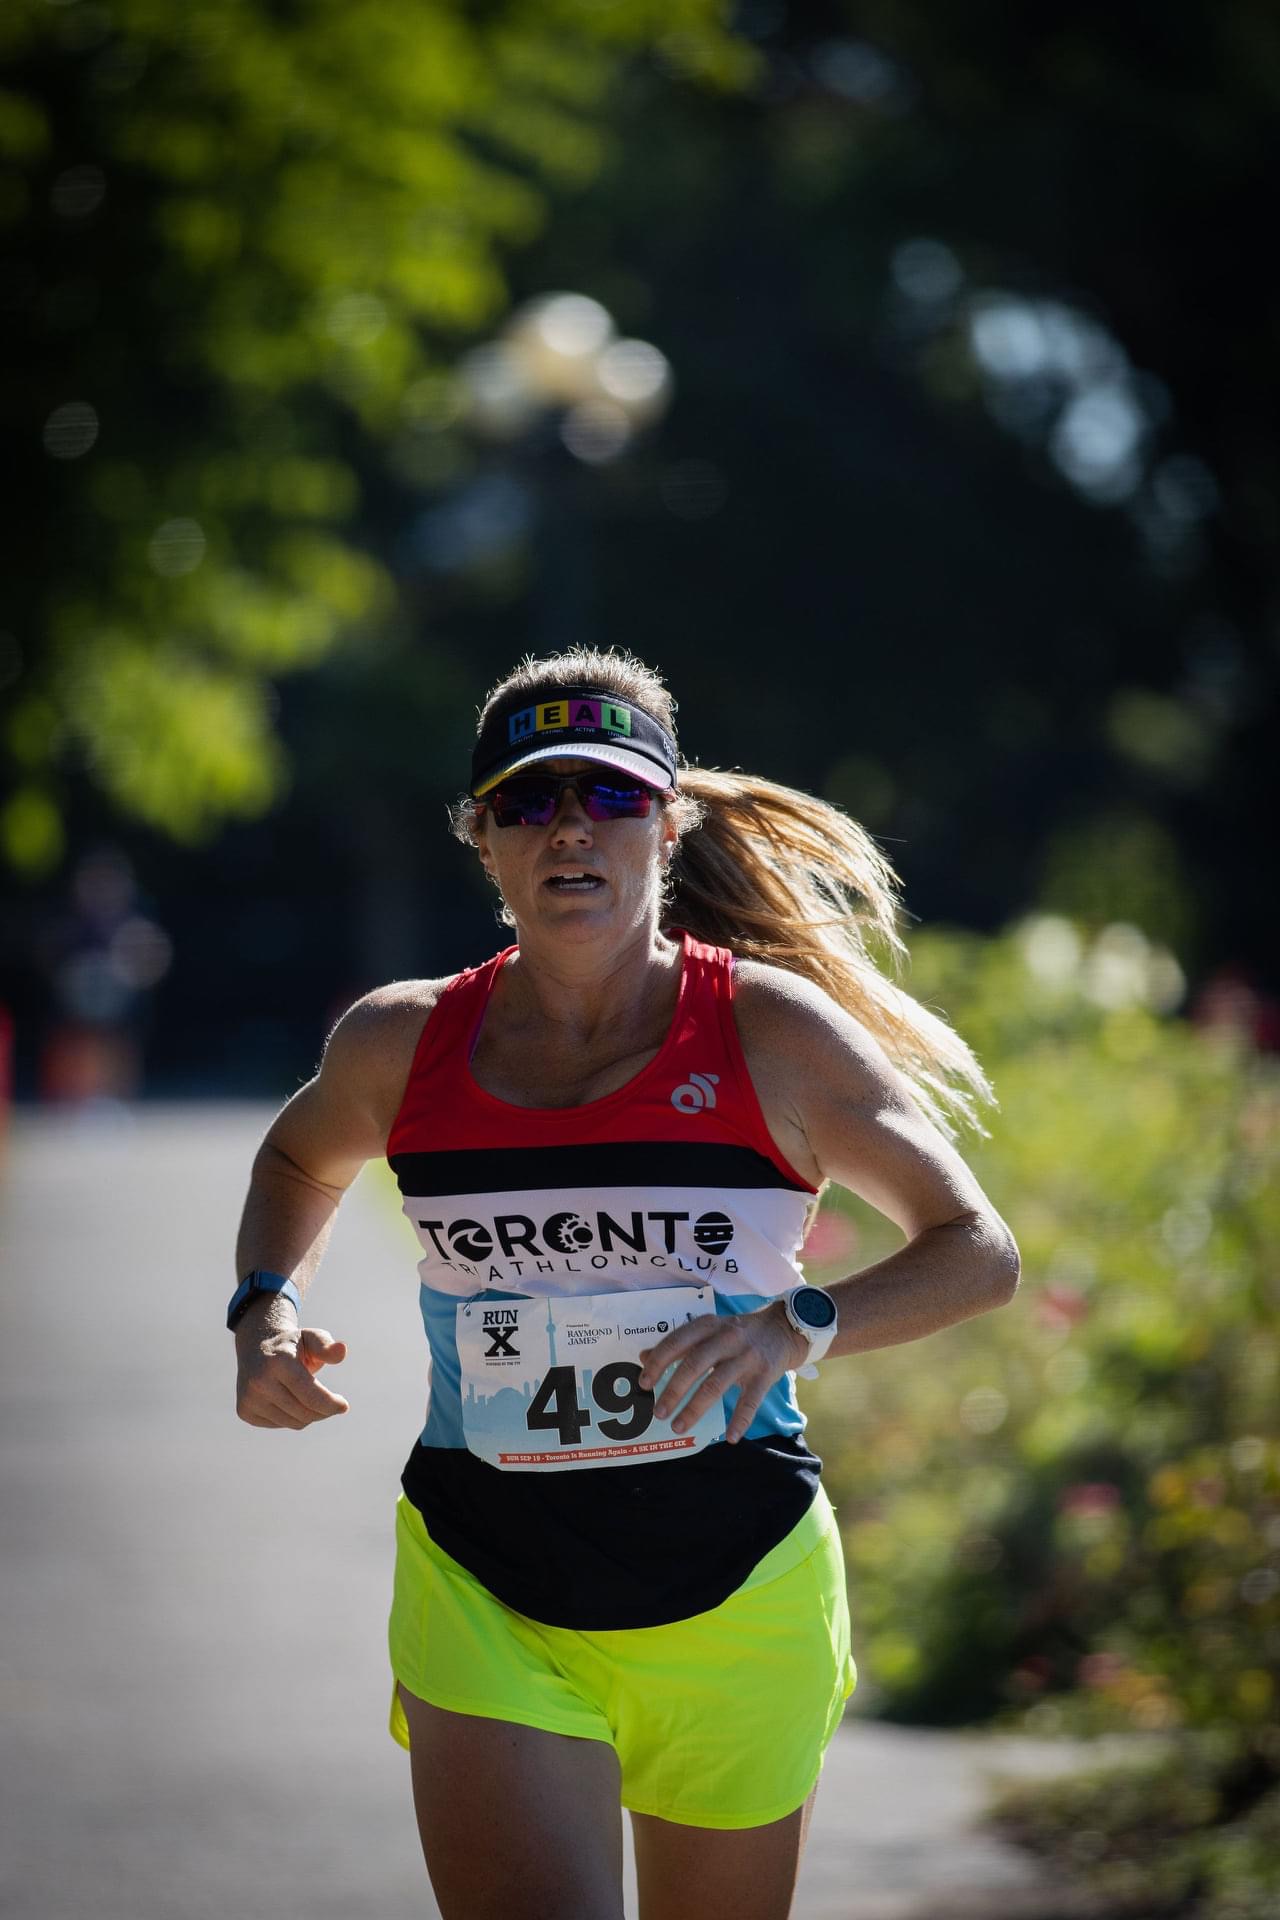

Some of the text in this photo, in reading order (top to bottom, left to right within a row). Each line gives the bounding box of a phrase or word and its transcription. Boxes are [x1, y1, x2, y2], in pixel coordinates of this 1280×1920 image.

[513, 704, 625, 736] HEAL
[418, 1211, 734, 1262] TORONTO
[482, 1310, 518, 1325] RUN
[567, 1328, 613, 1338] RAYMOND
[624, 1325, 656, 1336] Ontario
[482, 1326, 520, 1357] X
[567, 1337, 598, 1346] JAMES
[526, 1361, 655, 1445] 49
[545, 1453, 570, 1461] Toronto
[578, 1450, 607, 1459] Running
[607, 1448, 628, 1457] Again
